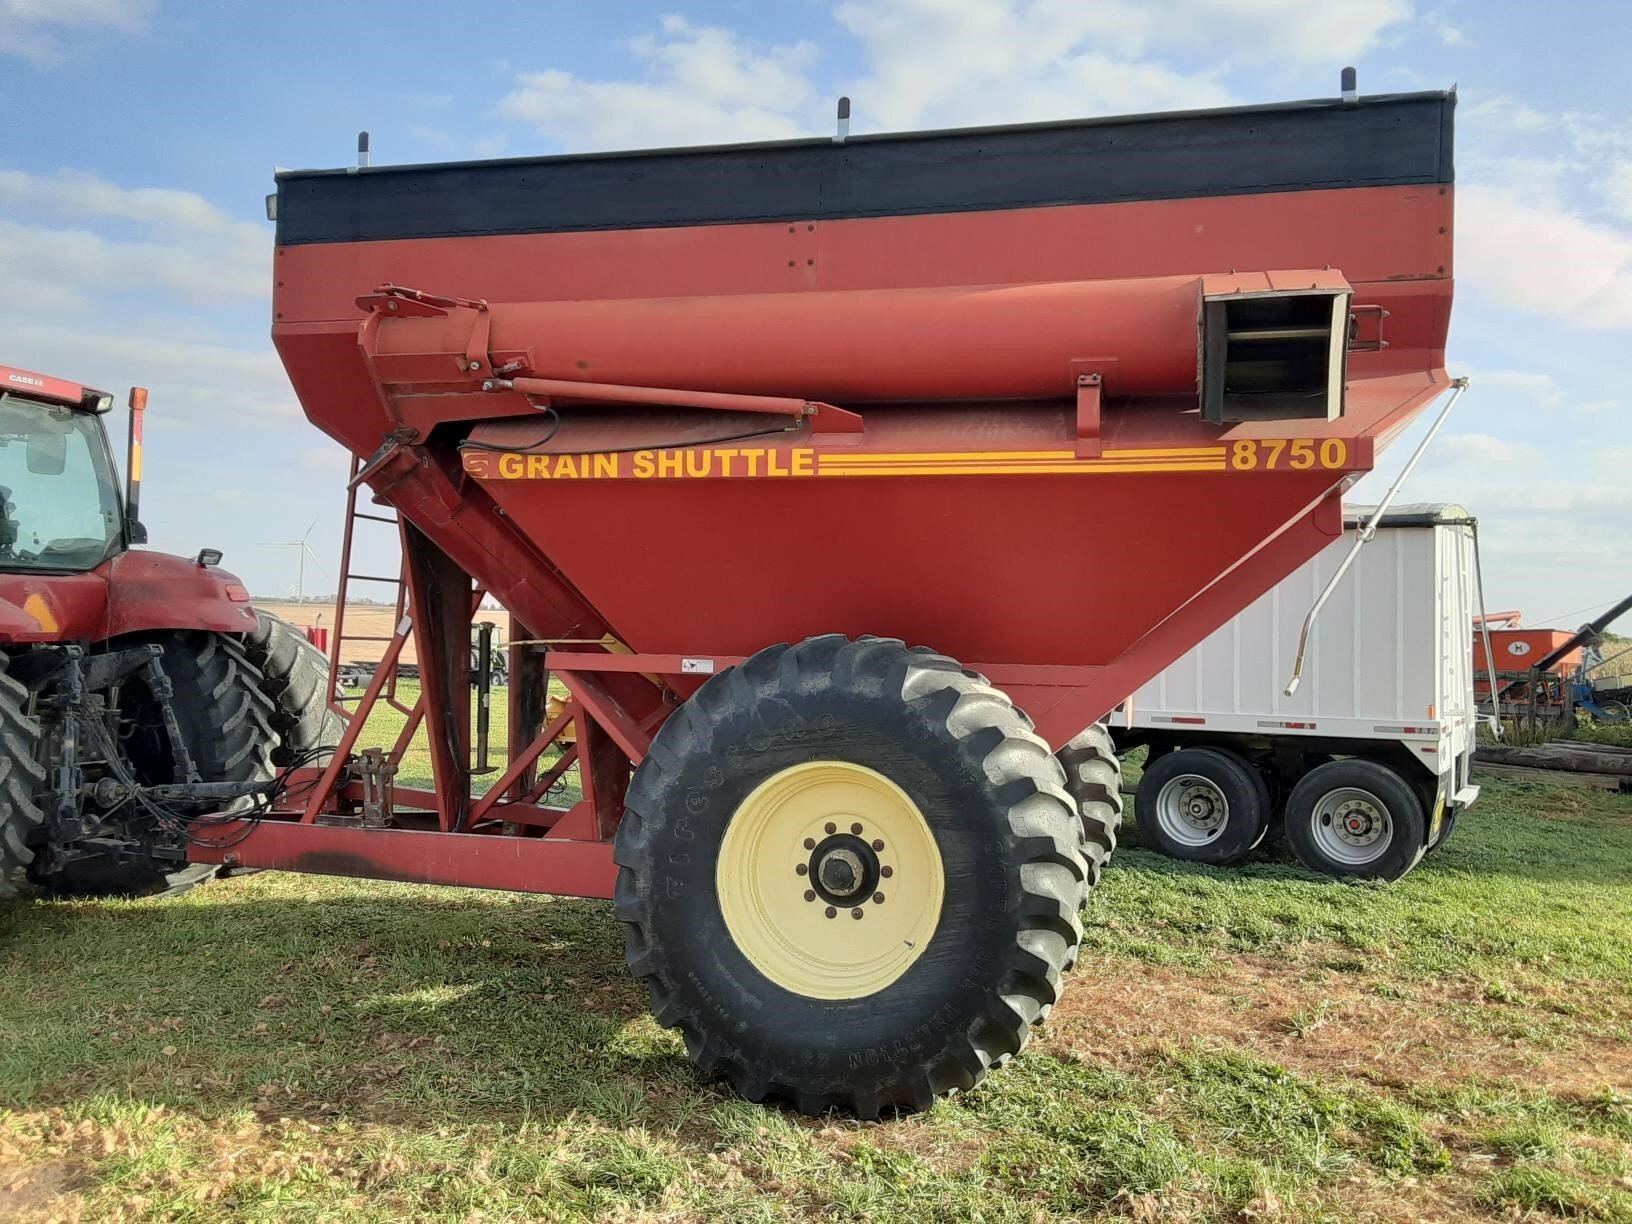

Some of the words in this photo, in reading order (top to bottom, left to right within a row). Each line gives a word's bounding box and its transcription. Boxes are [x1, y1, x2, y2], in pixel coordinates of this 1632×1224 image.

[9, 374, 33, 385] CASE
[498, 452, 620, 480] GRAIN
[632, 448, 815, 479] SHUTTLE
[1231, 438, 1347, 470] 8750
